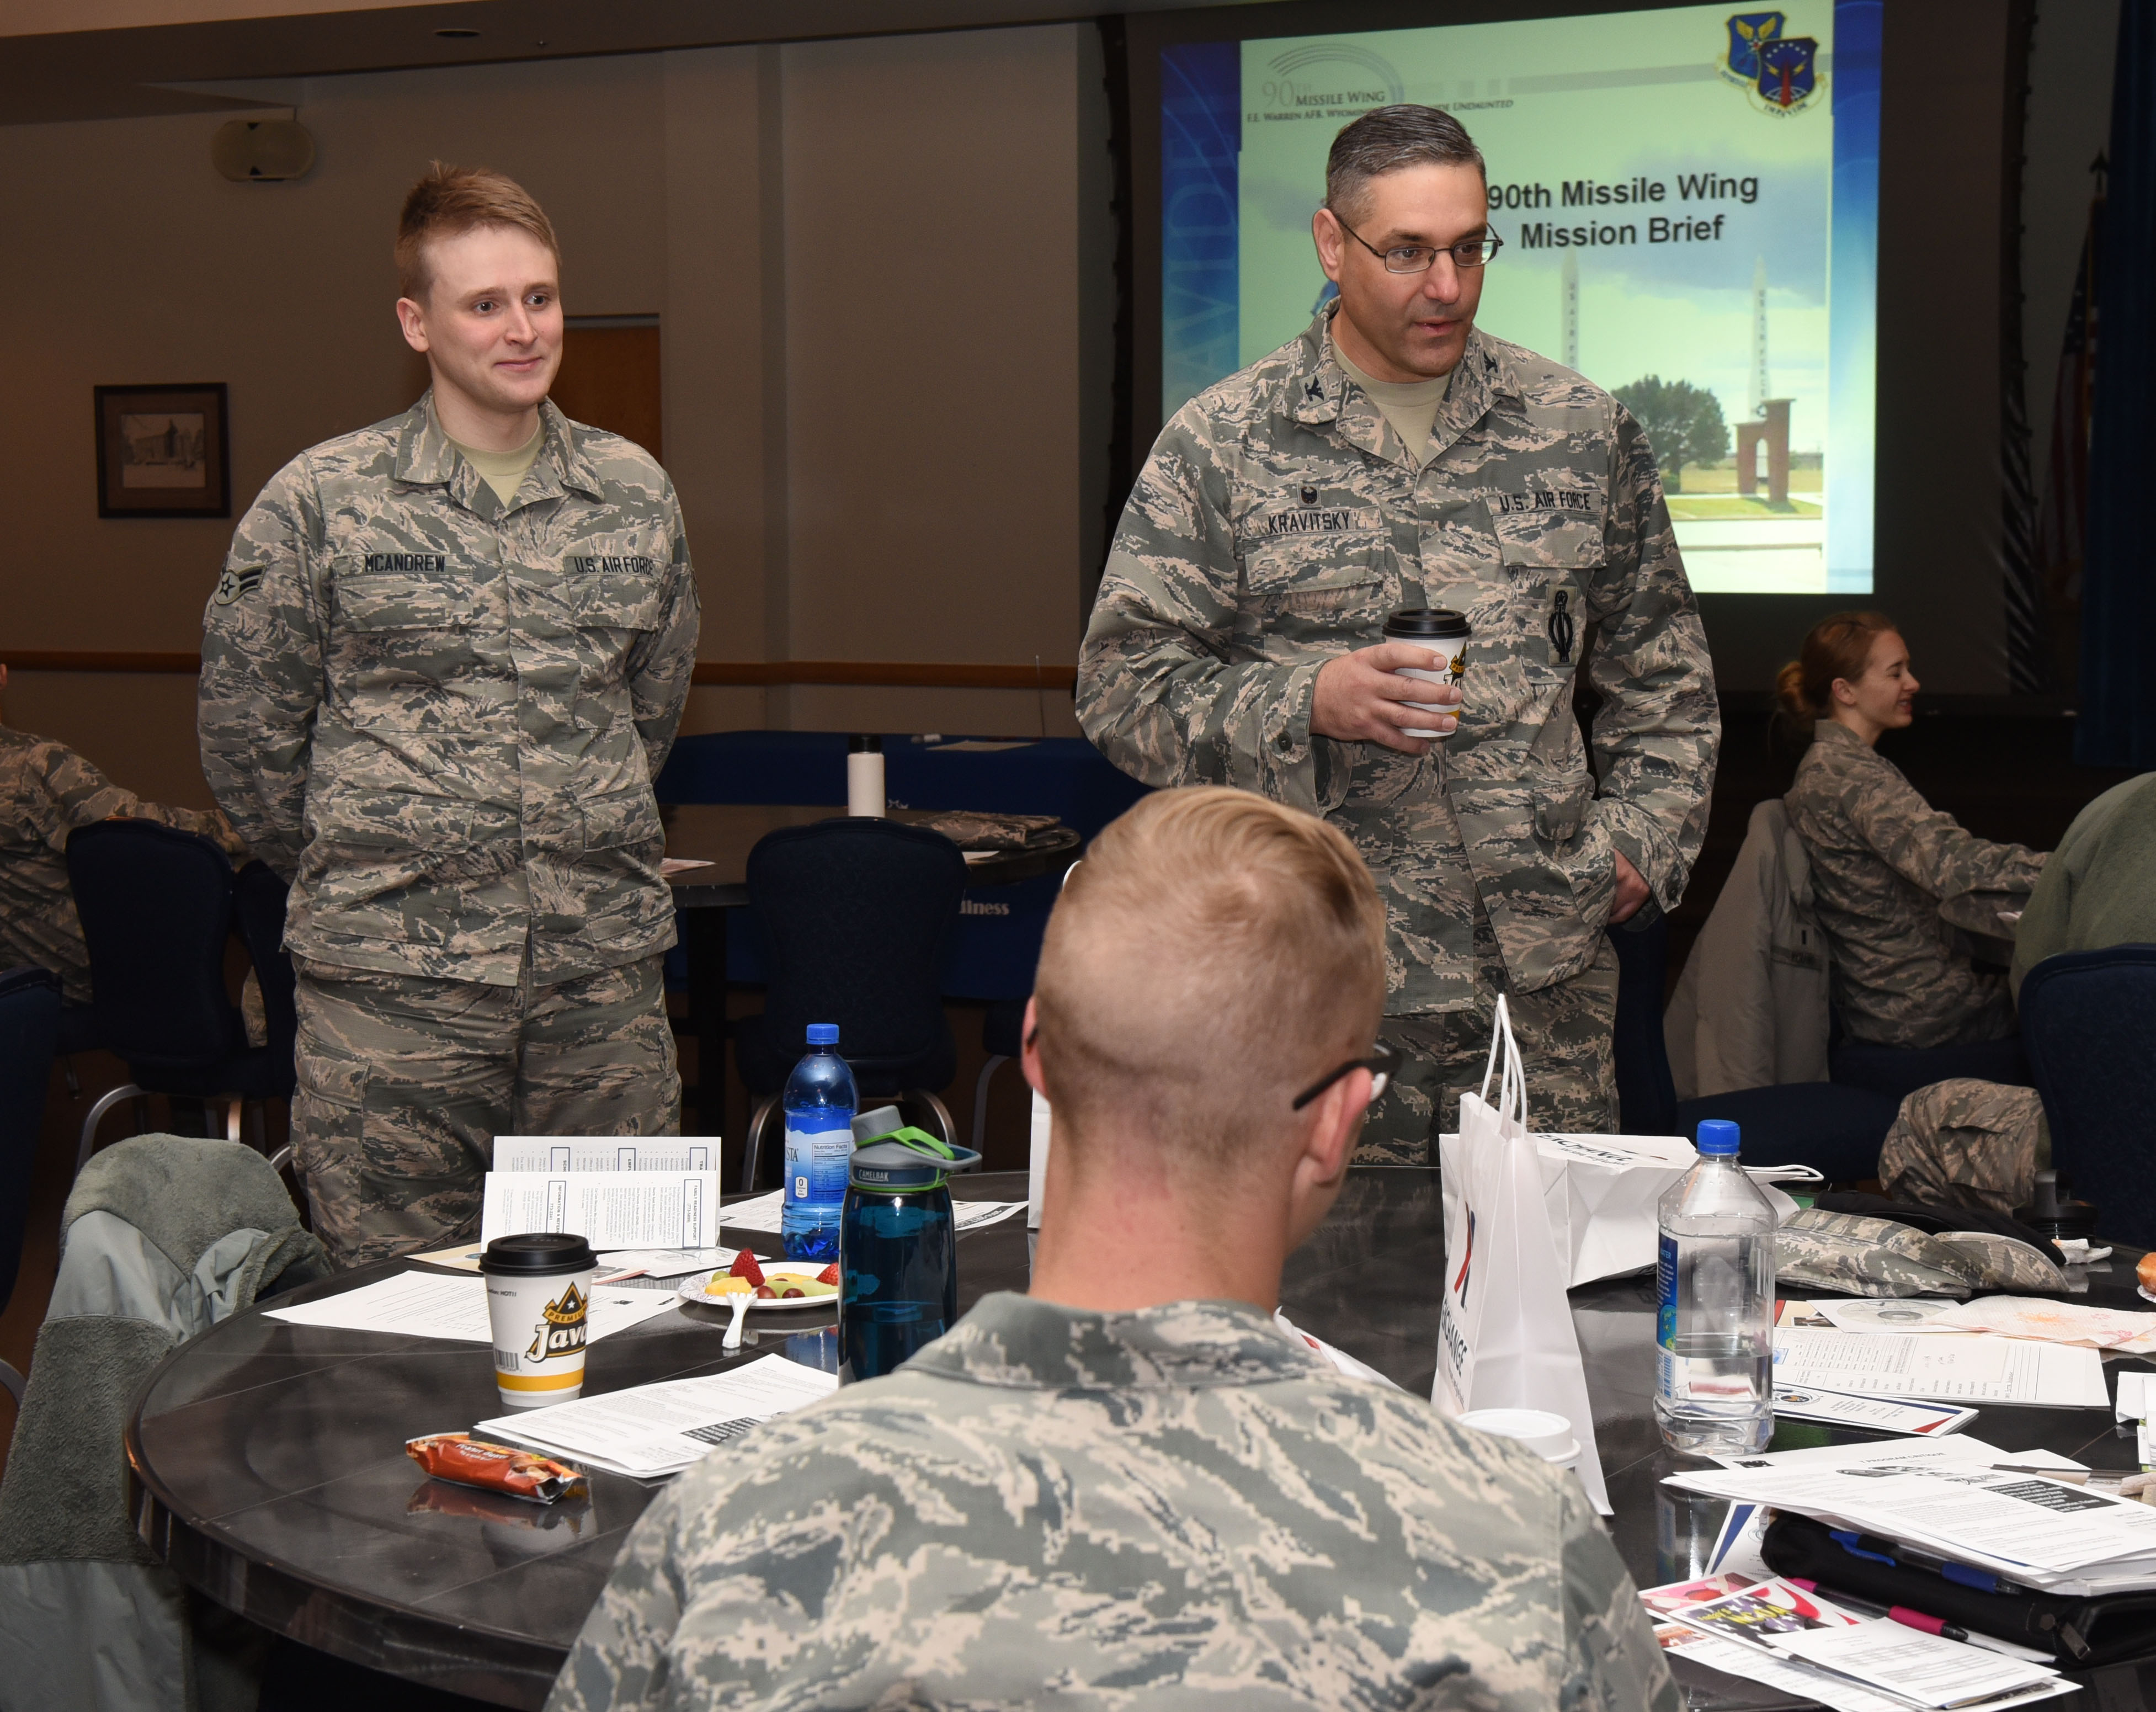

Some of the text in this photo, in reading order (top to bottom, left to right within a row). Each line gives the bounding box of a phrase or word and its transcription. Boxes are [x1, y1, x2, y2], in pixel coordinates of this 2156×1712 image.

[1348, 91, 1386, 104] WING
[1263, 111, 1302, 121] WARREN
[1452, 99, 1514, 111] UNDAUNTED
[1488, 172, 1759, 210] 90th Missile Wing
[1520, 214, 1726, 250] Mission Brief
[1500, 490, 1592, 513] U.S. AIR FORCE
[1269, 511, 1350, 534] KRAVITSKY
[364, 554, 446, 574] MCANDREW
[574, 556, 653, 576] U.S. AIR FORCE
[798, 1178, 804, 1187] 0
[859, 1169, 889, 1182] CAMELBAK
[1866, 1455, 1907, 1463] PROGRAM
[1907, 1452, 1947, 1460] CRITIQUE
